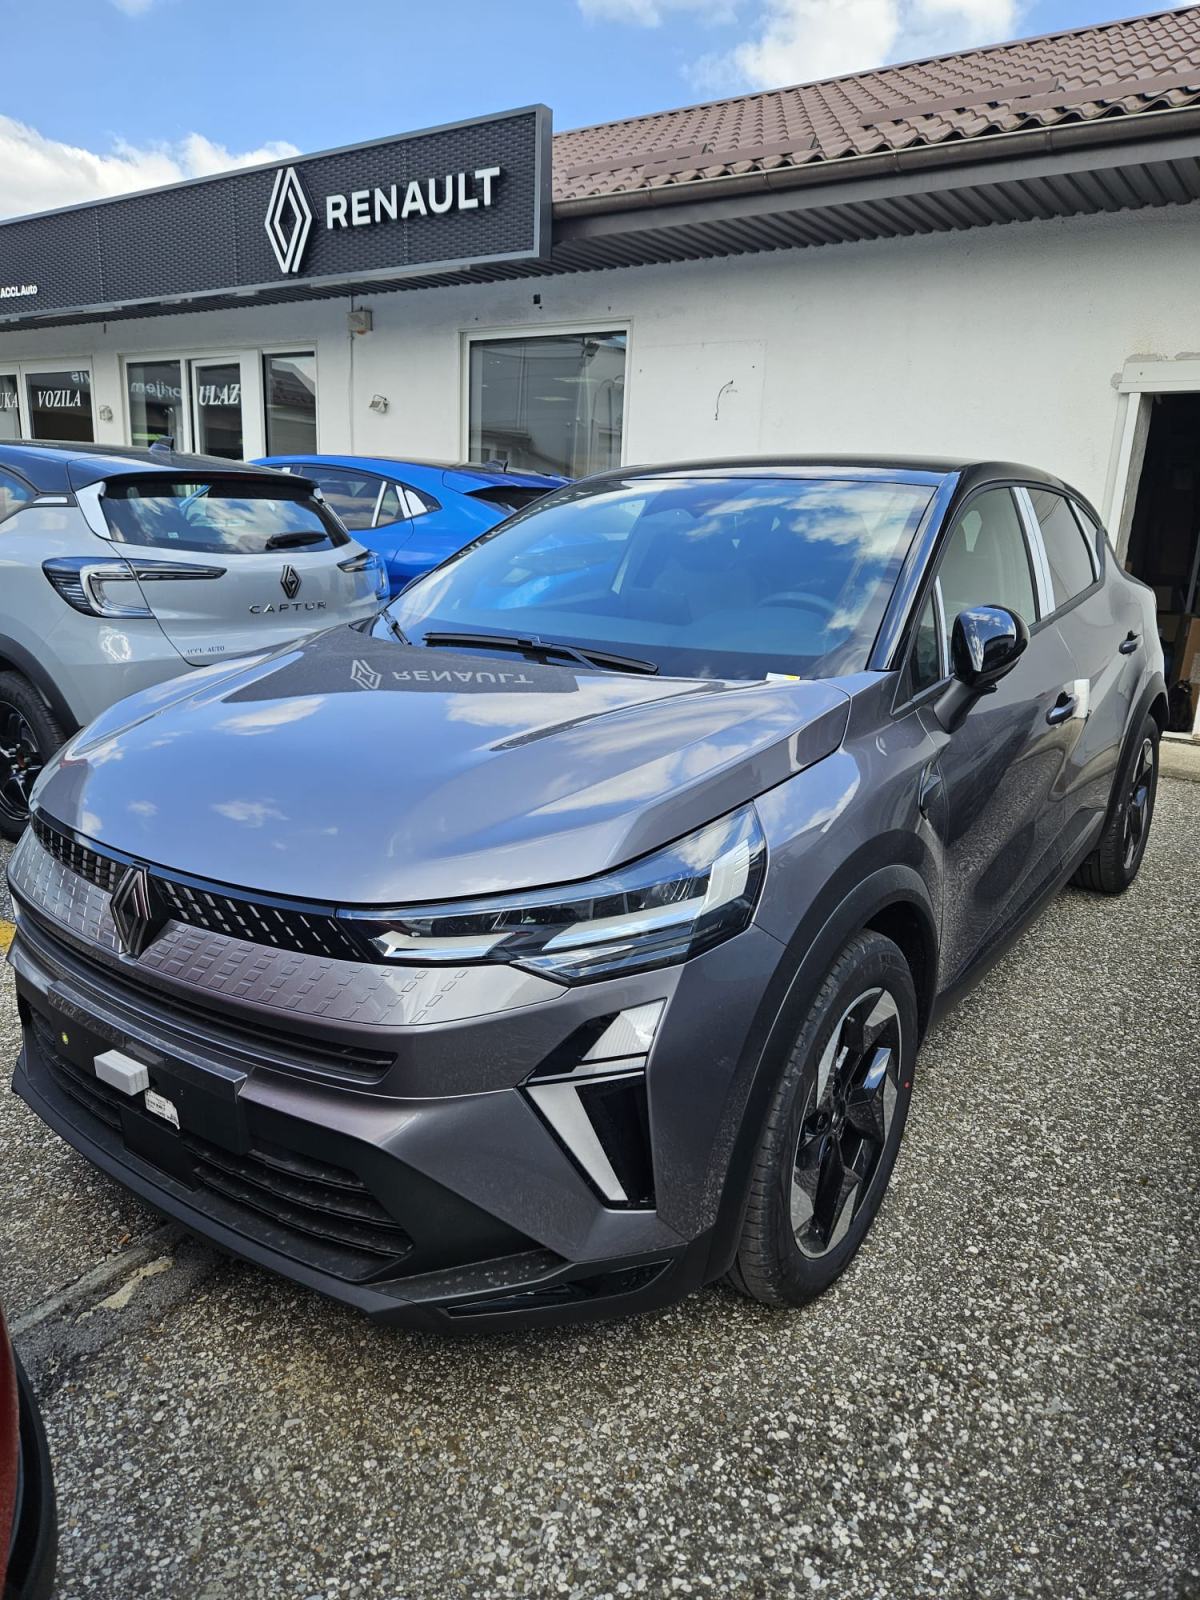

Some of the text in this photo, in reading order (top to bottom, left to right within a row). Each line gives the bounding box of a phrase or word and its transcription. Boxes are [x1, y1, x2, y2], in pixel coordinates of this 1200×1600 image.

[326, 166, 500, 229] RENAULT
[0, 284, 38, 299] ACCL Auto
[38, 389, 81, 408] VOZILA
[199, 383, 240, 406] ULAZ
[249, 601, 326, 615] CAPTUR
[207, 645, 225, 653] AUTO
